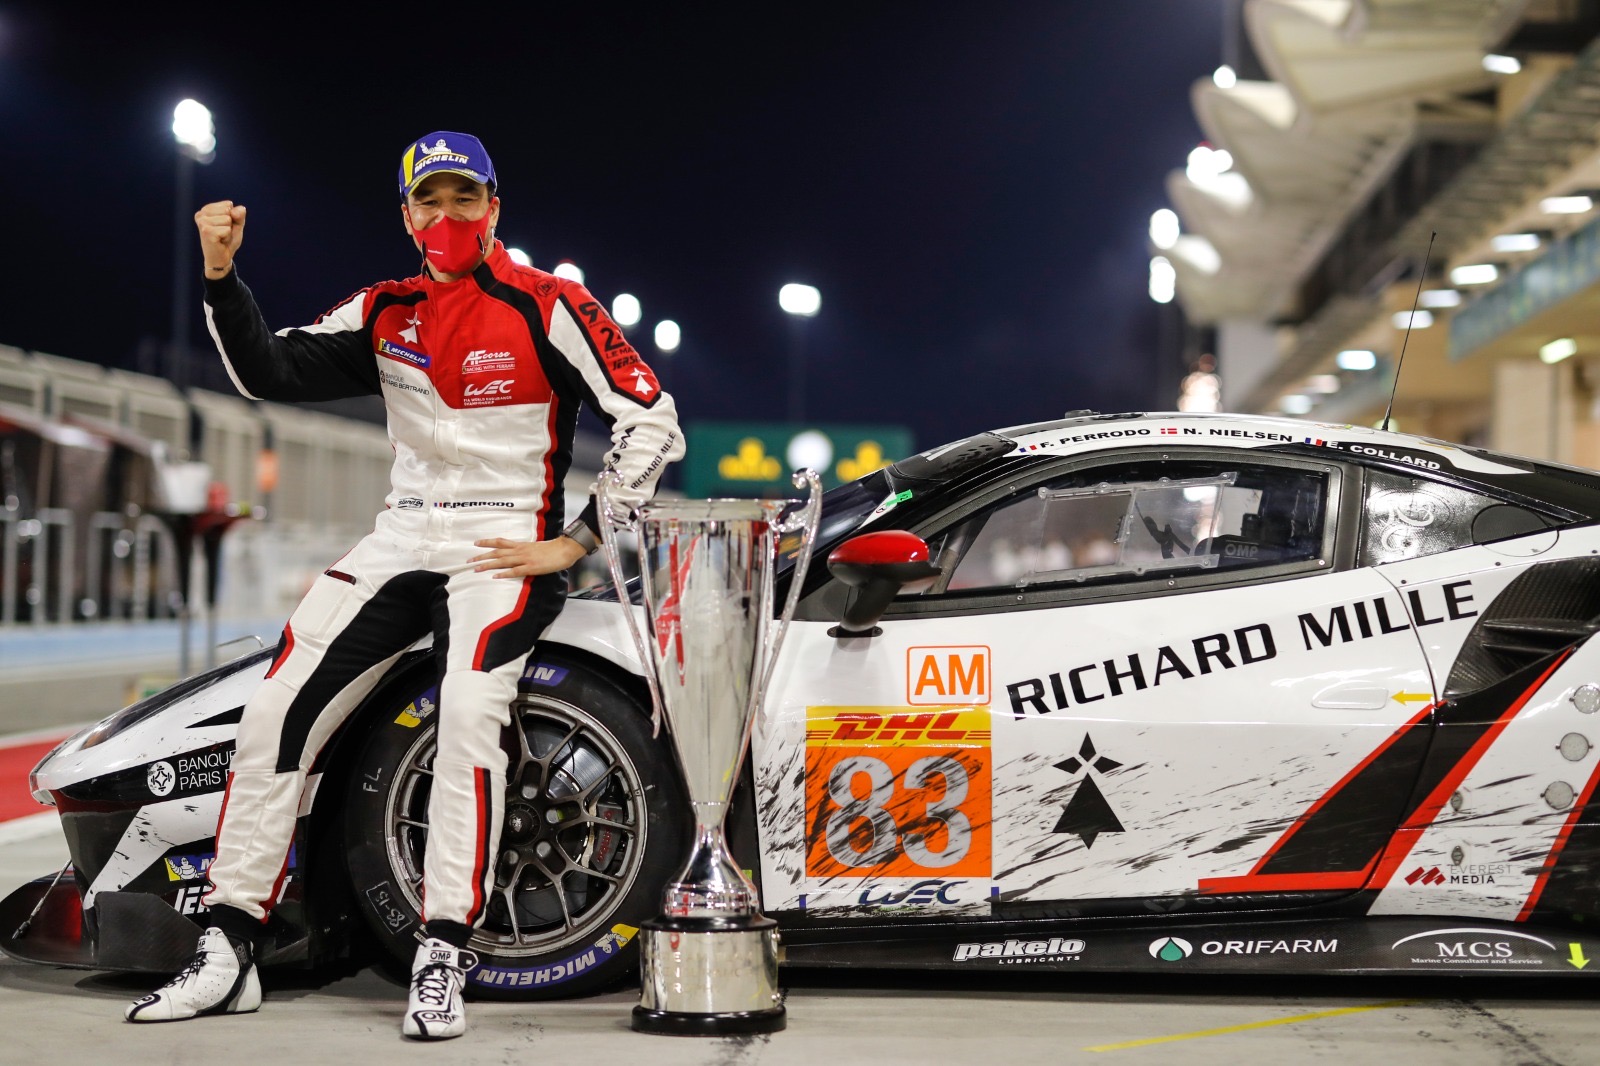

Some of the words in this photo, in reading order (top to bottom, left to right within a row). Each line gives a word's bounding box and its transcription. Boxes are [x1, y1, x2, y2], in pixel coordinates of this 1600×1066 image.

[415, 155, 468, 174] MICHELIN
[390, 347, 427, 364] MICHELIN
[606, 351, 618, 359] LE
[619, 347, 634, 355] MA
[398, 383, 430, 395] BERTRAND
[464, 379, 515, 397] WEC
[1040, 440, 1056, 450] F.
[1059, 427, 1152, 445] PERRODO
[1182, 426, 1204, 437] N.
[1209, 427, 1293, 442] NIELSEN
[1326, 440, 1345, 450] E.
[1349, 443, 1441, 471] COLLARD
[630, 455, 663, 491] RICHARD
[1224, 543, 1258, 558] OMP
[1006, 622, 1278, 721] RICHARD
[1298, 579, 1479, 651] MILLE
[914, 654, 985, 695] AM
[832, 712, 969, 740] DHL
[180, 771, 221, 791] PÂRIS
[825, 756, 972, 868] 83
[1450, 864, 1512, 875] EVEREST
[1450, 875, 1495, 884] MEDIA
[858, 880, 968, 905] WEC
[429, 951, 451, 961] OMP
[953, 937, 1086, 962] pakelo
[1200, 939, 1338, 956] ORIFARM
[1434, 942, 1513, 958] MCS
[476, 949, 597, 986] MICHELIN
[998, 955, 1081, 965] LUBRICANTS
[1411, 957, 1441, 965] Marine
[1442, 956, 1489, 964] Consultant
[1491, 956, 1507, 964] and
[1509, 957, 1543, 965] Services
